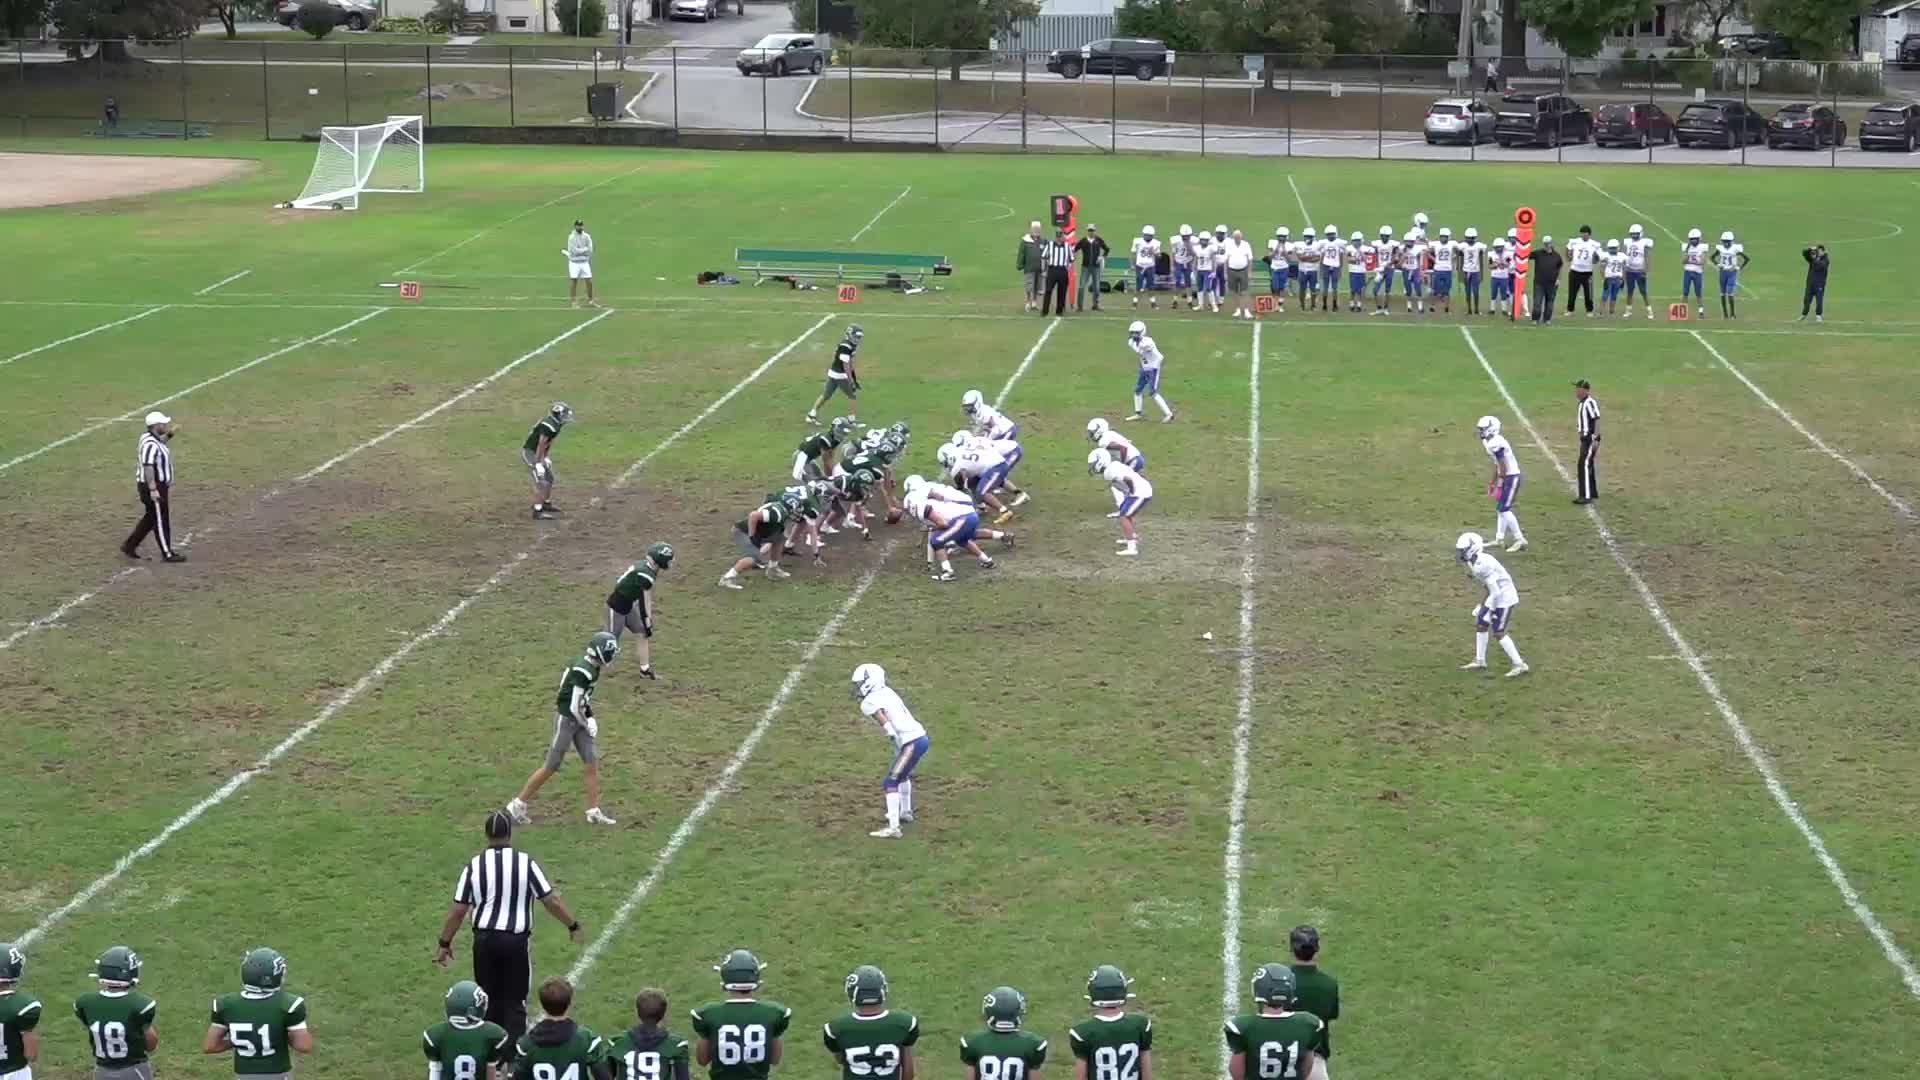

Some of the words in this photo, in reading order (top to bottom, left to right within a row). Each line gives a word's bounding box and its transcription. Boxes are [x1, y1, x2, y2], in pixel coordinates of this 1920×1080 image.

[1577, 249, 1589, 260] 73
[839, 286, 855, 301] 40
[1257, 297, 1272, 311] 50
[1670, 304, 1687, 319] 40
[90, 1020, 128, 1059] 18
[229, 1022, 276, 1057] 51
[717, 1023, 767, 1065] 68
[623, 1050, 661, 1080] 19
[845, 1043, 900, 1076] 53
[1094, 1042, 1140, 1080] 82
[1258, 1040, 1300, 1079] 61
